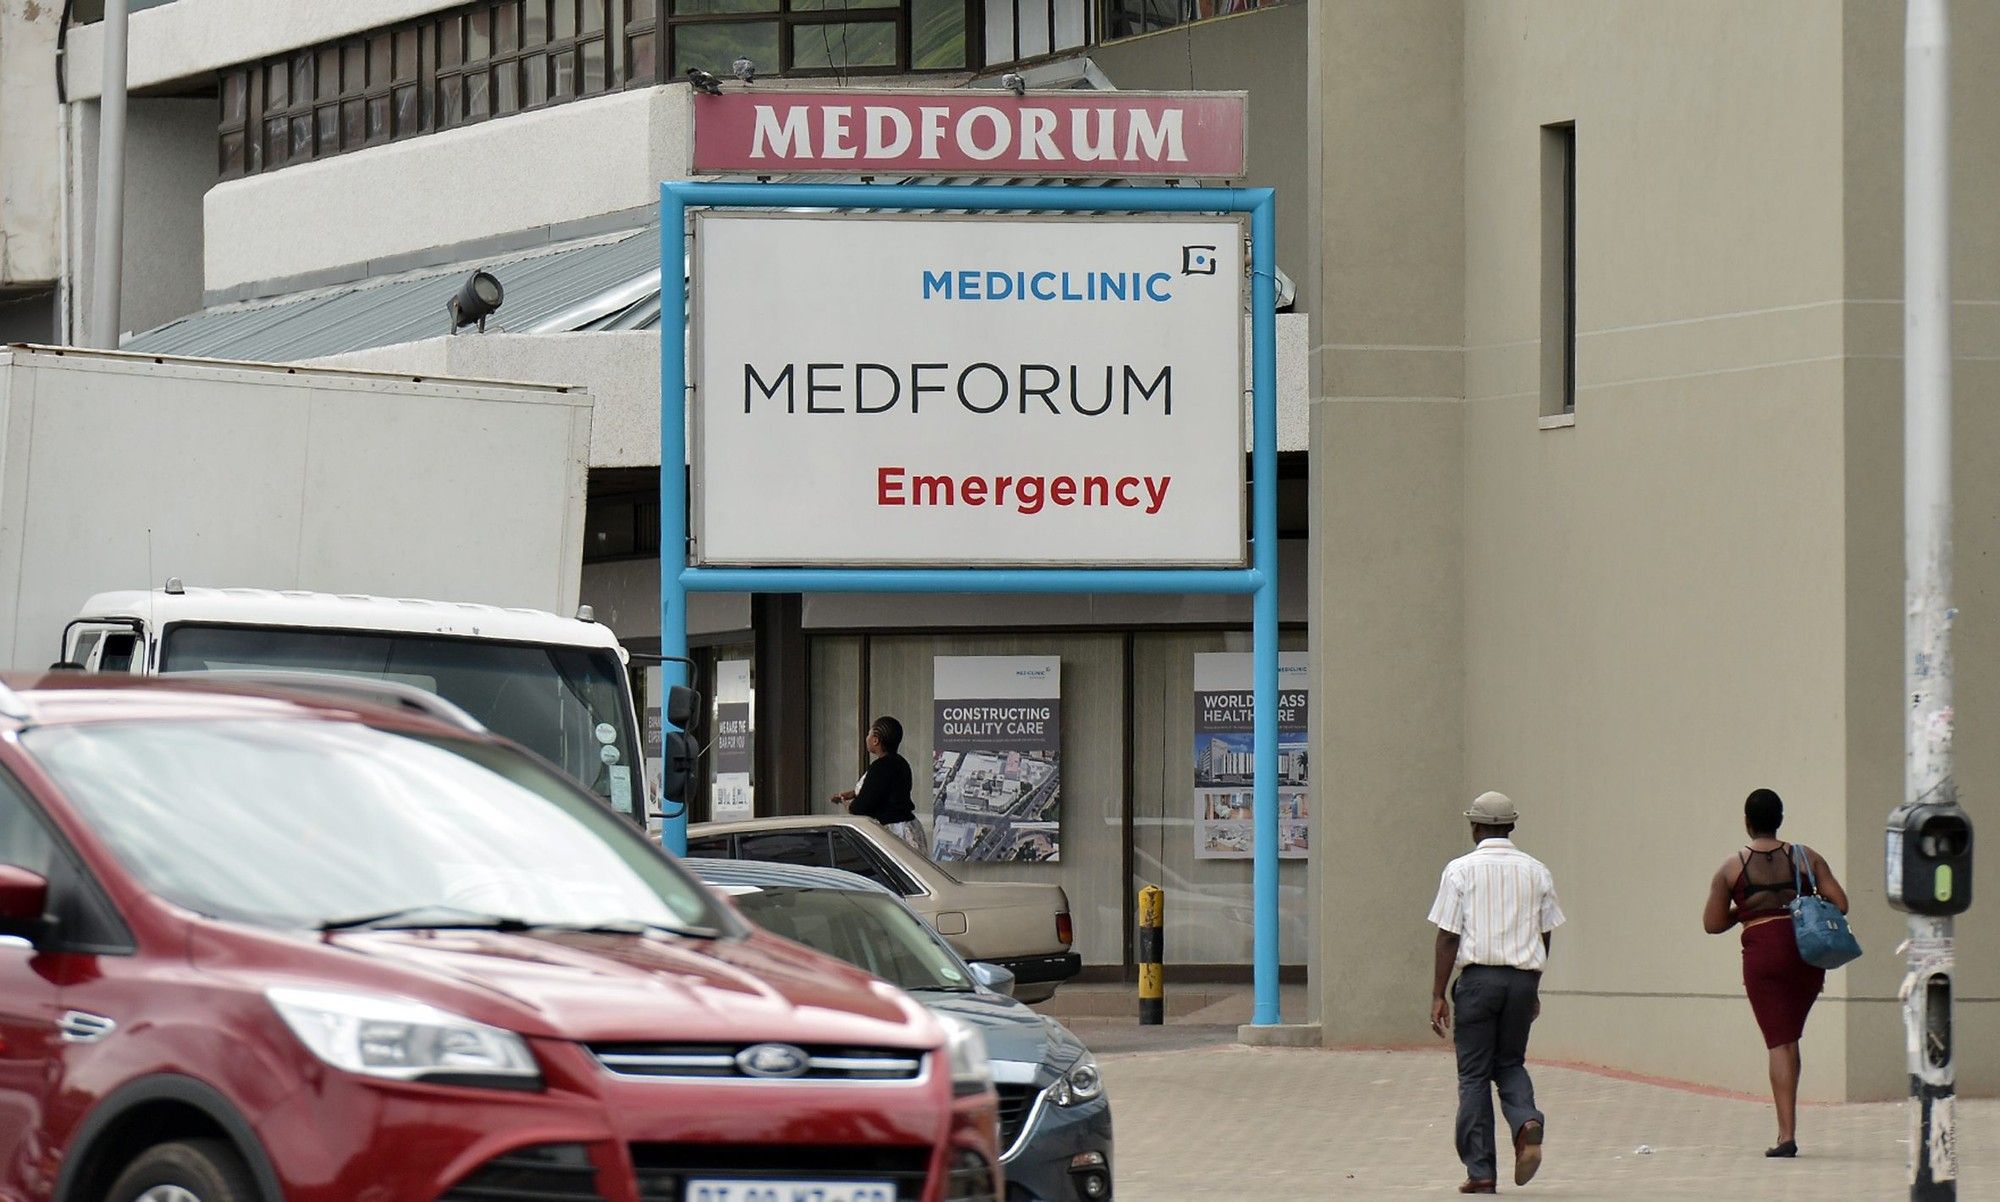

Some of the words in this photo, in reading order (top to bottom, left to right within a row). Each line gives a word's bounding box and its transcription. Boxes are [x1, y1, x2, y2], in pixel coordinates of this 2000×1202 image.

[749, 105, 1189, 163] MEDFORUM
[922, 270, 1172, 301] MEDICLINIC
[744, 362, 1172, 416] MEDFORUM
[877, 467, 1171, 514] Emergency
[1204, 694, 1255, 708] WORLD
[943, 707, 1051, 721] CONSTRUCTING
[1204, 709, 1295, 722] HEALTHRE
[943, 722, 1003, 735] QUALITY
[1006, 721, 1044, 735] CARE
